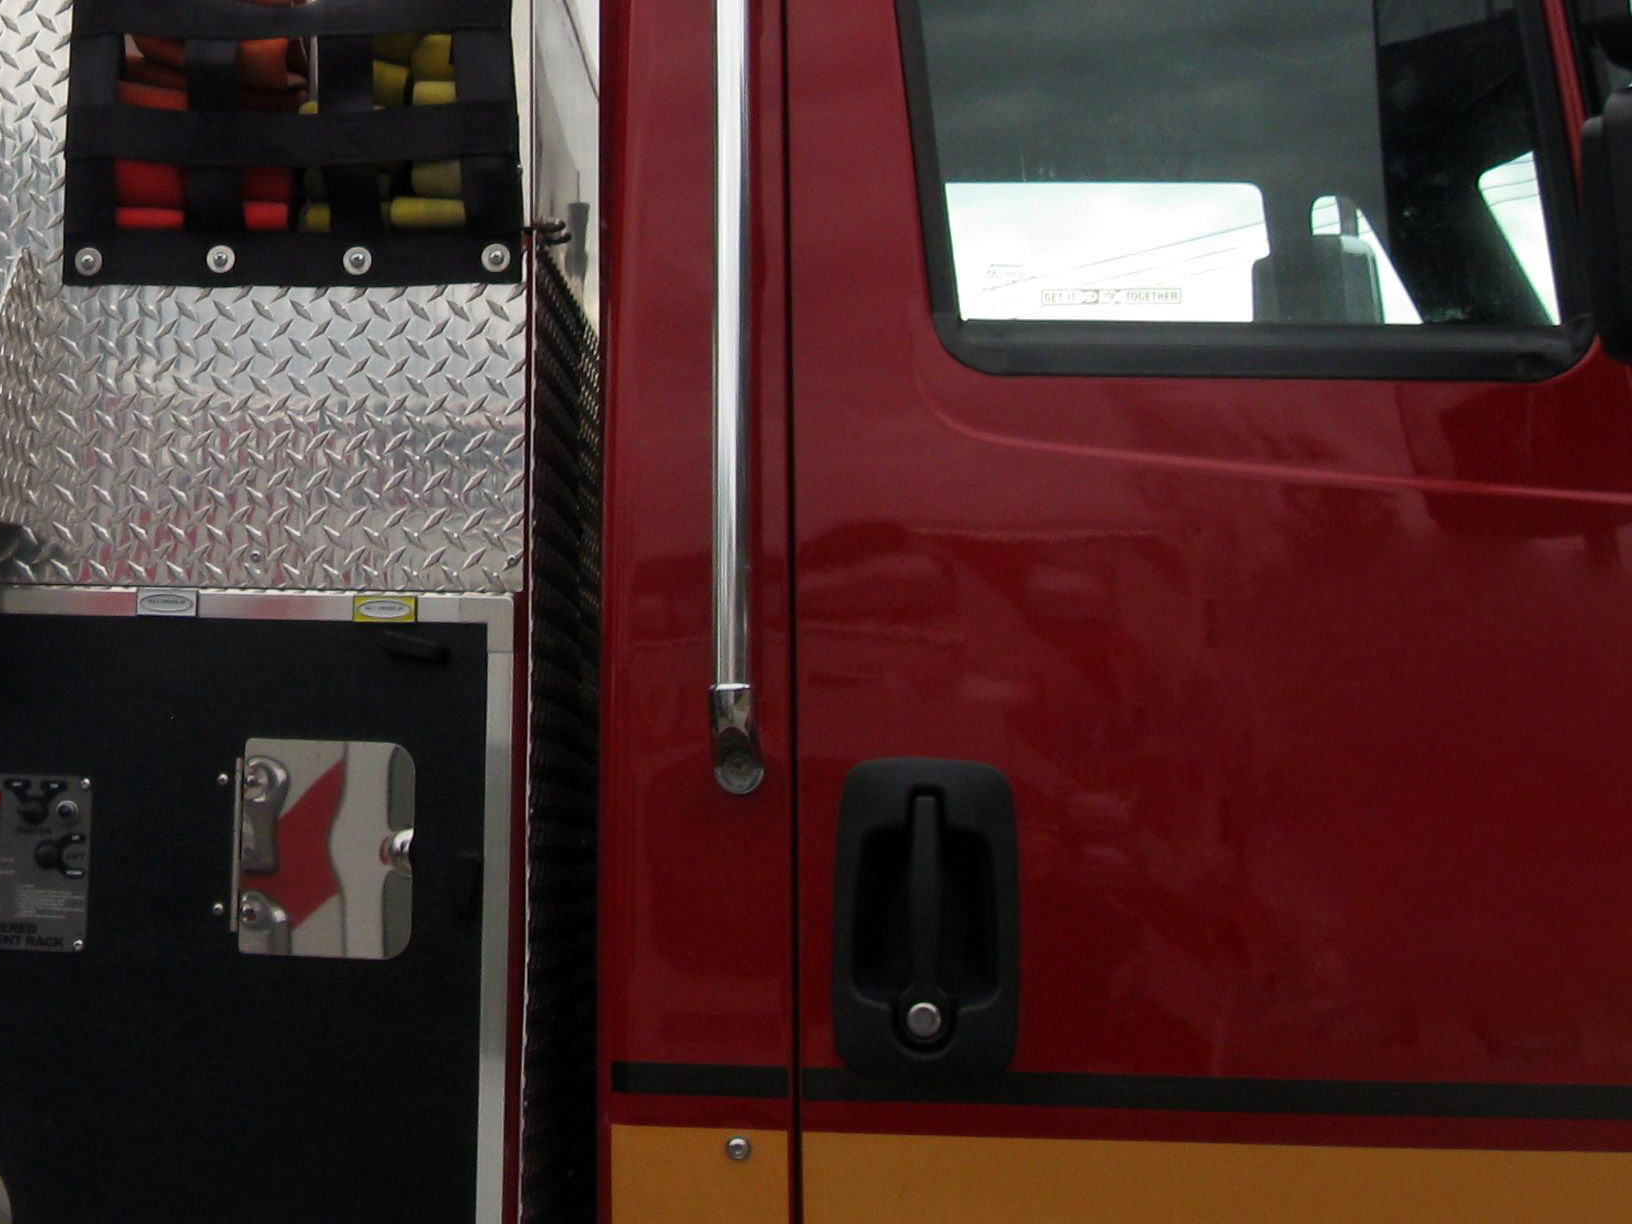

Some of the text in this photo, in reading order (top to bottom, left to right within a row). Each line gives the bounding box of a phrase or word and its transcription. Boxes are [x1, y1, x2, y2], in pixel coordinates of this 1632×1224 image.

[1044, 291, 1179, 303] GET IT TOGETHER
[25, 935, 64, 947] RACK
